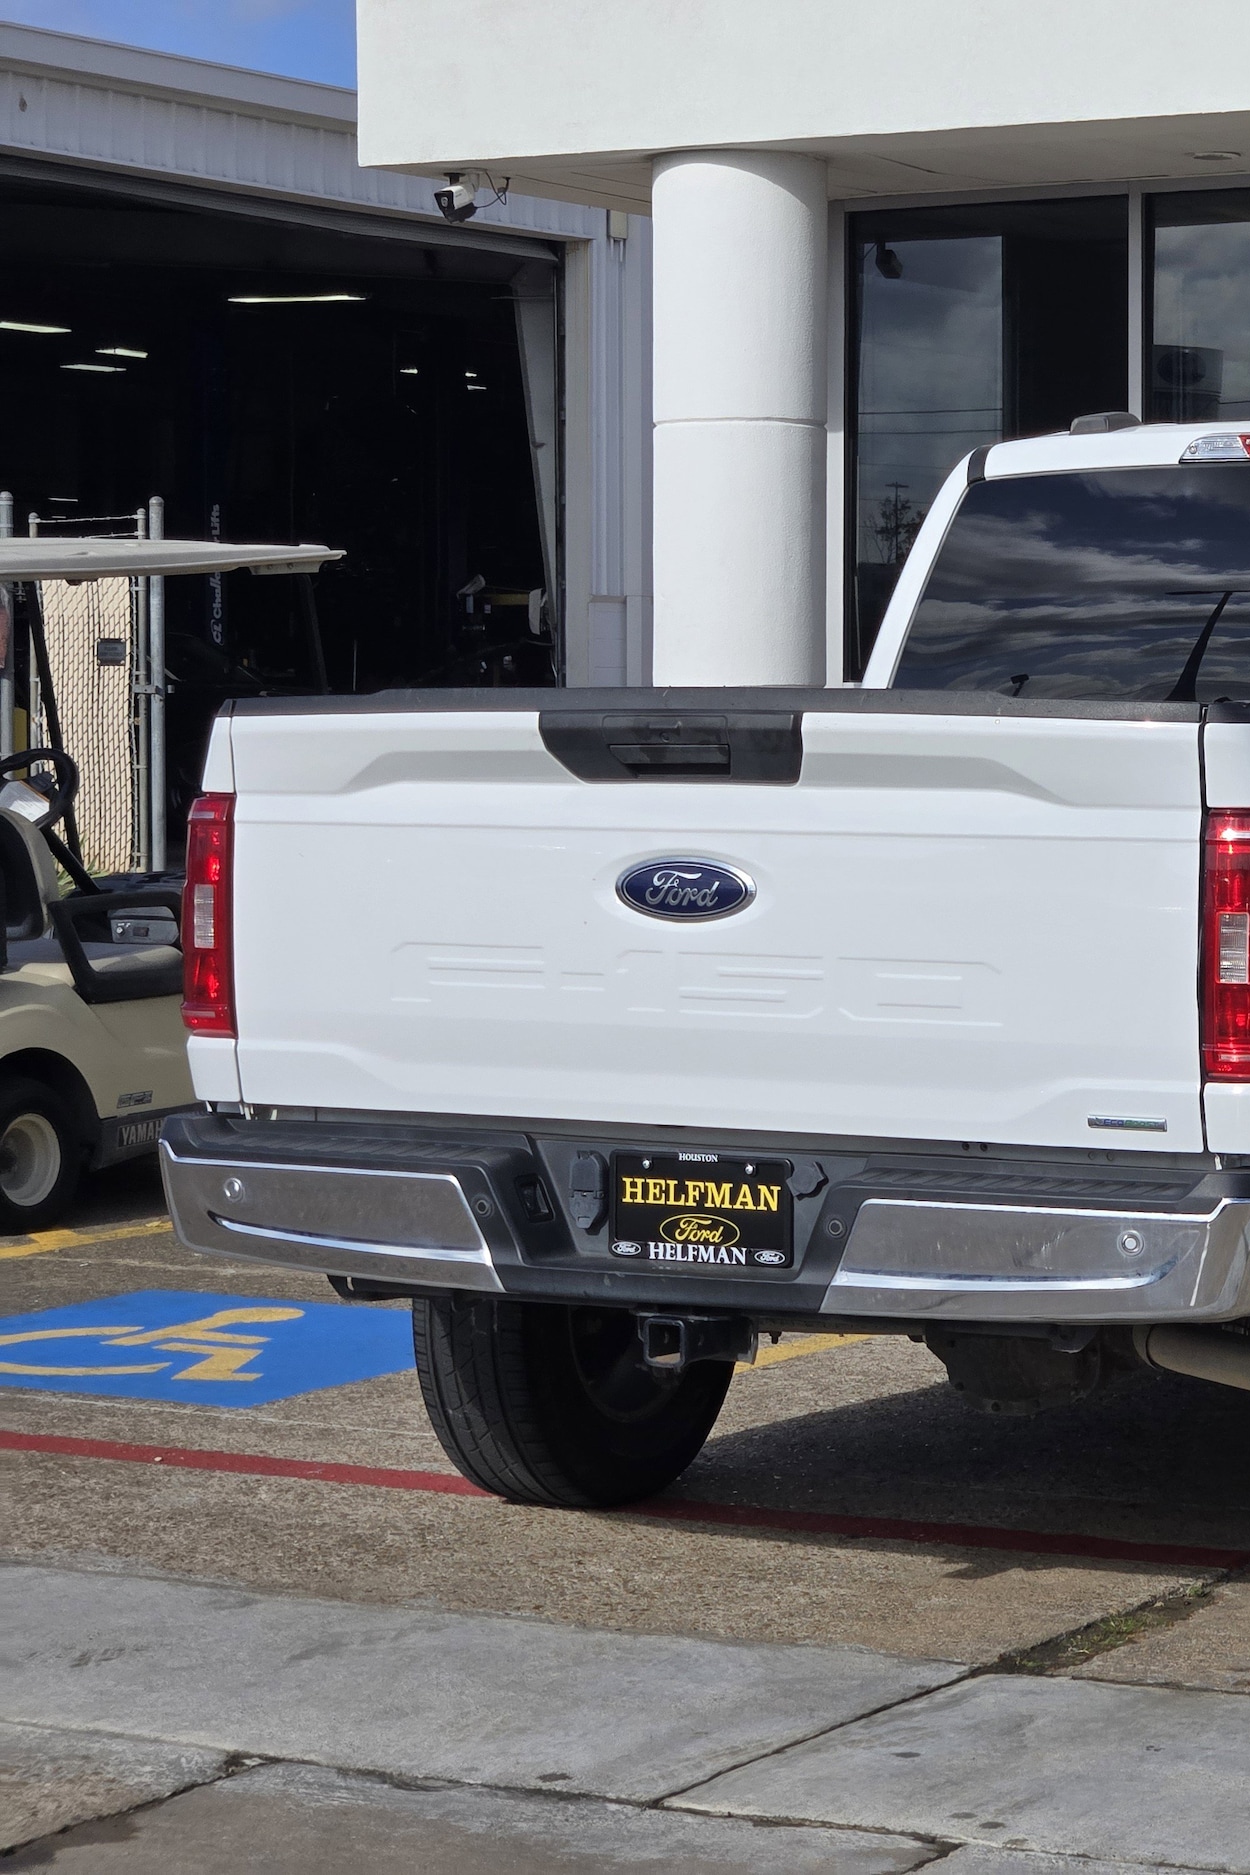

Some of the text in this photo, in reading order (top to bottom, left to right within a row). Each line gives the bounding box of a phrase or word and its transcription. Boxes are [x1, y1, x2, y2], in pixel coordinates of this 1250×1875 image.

[210, 504, 220, 536] Lifts
[645, 869, 720, 908] Ford
[121, 1120, 163, 1146] YAMAH
[678, 1152, 718, 1163] HOUSTON
[621, 1177, 782, 1212] HELFMAN
[674, 1217, 724, 1243] Ford
[617, 1243, 637, 1253] Ford
[648, 1242, 747, 1265] HELFMAN
